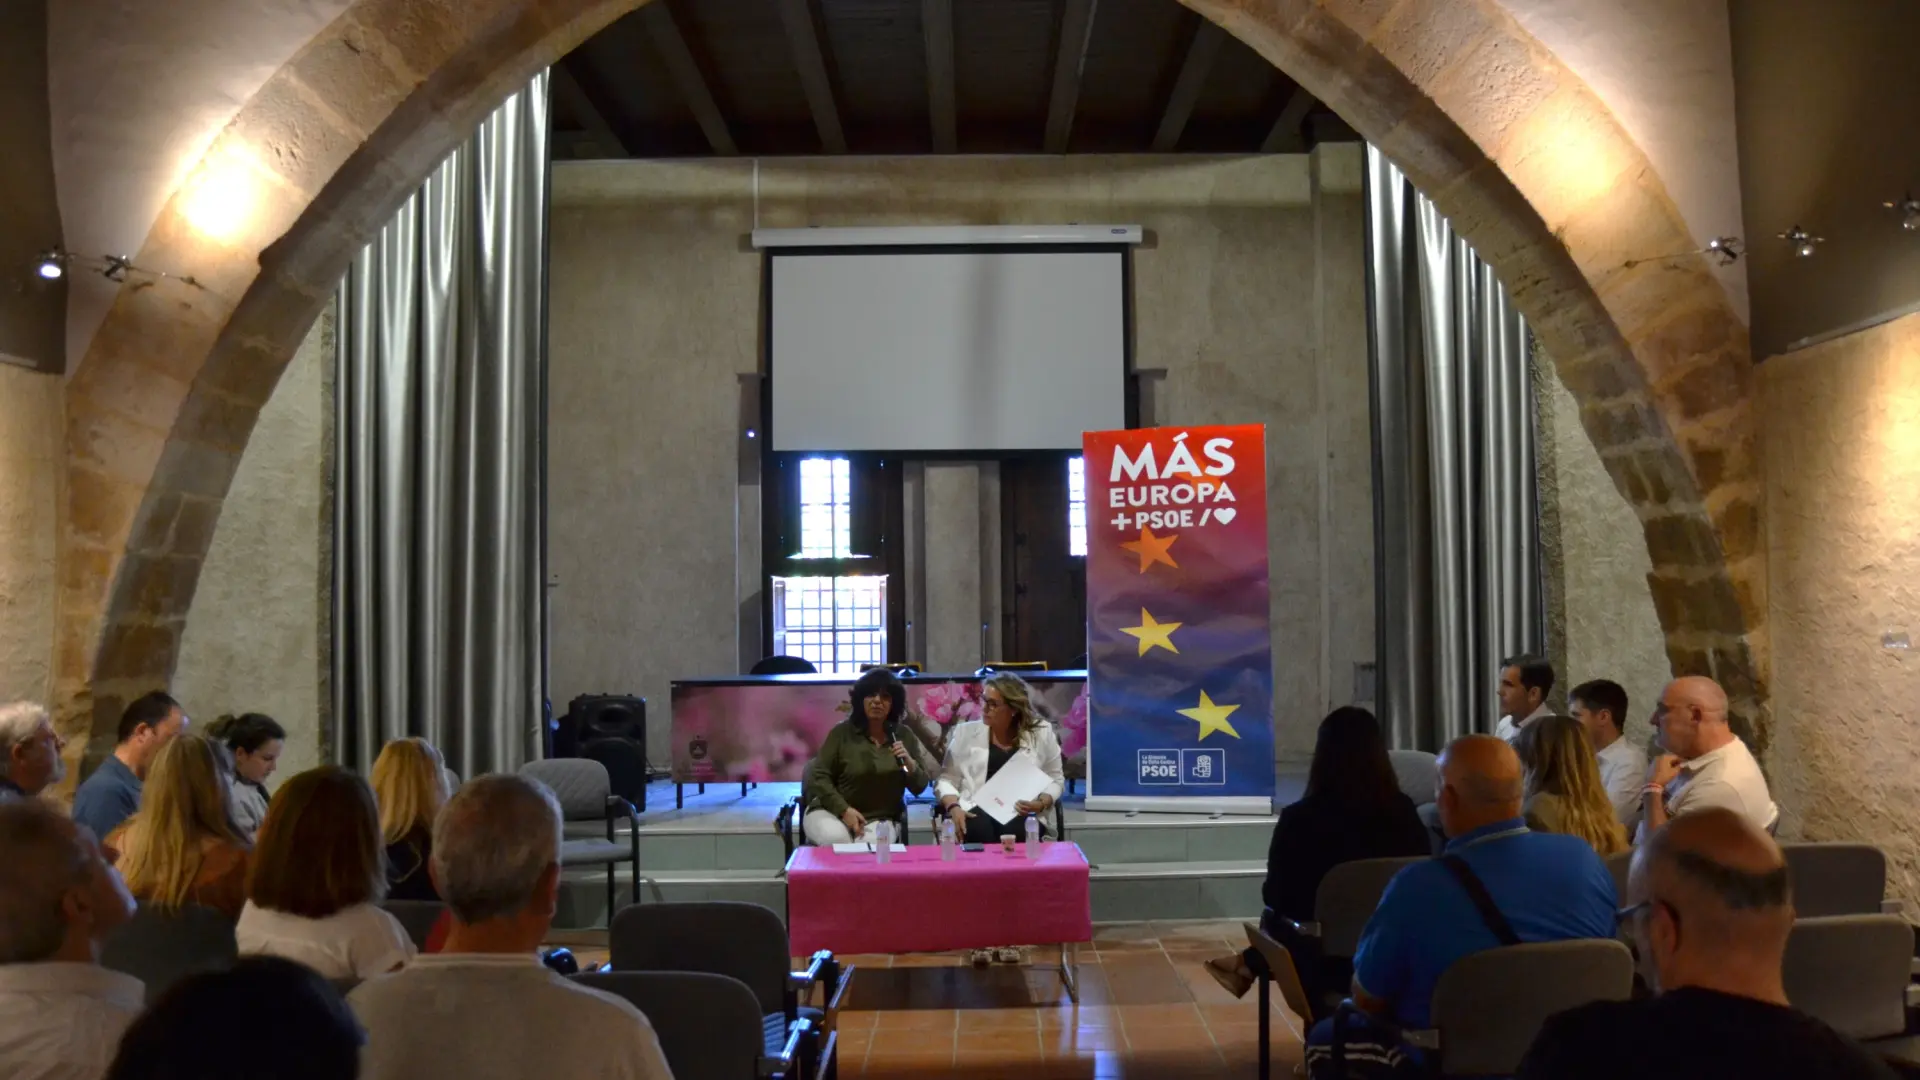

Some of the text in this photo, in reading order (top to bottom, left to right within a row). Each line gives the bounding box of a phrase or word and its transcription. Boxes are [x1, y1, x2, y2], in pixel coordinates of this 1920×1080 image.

[1110, 432, 1235, 482] MÁS
[1110, 482, 1236, 508] EUROPA
[1141, 765, 1177, 778] PSOE
